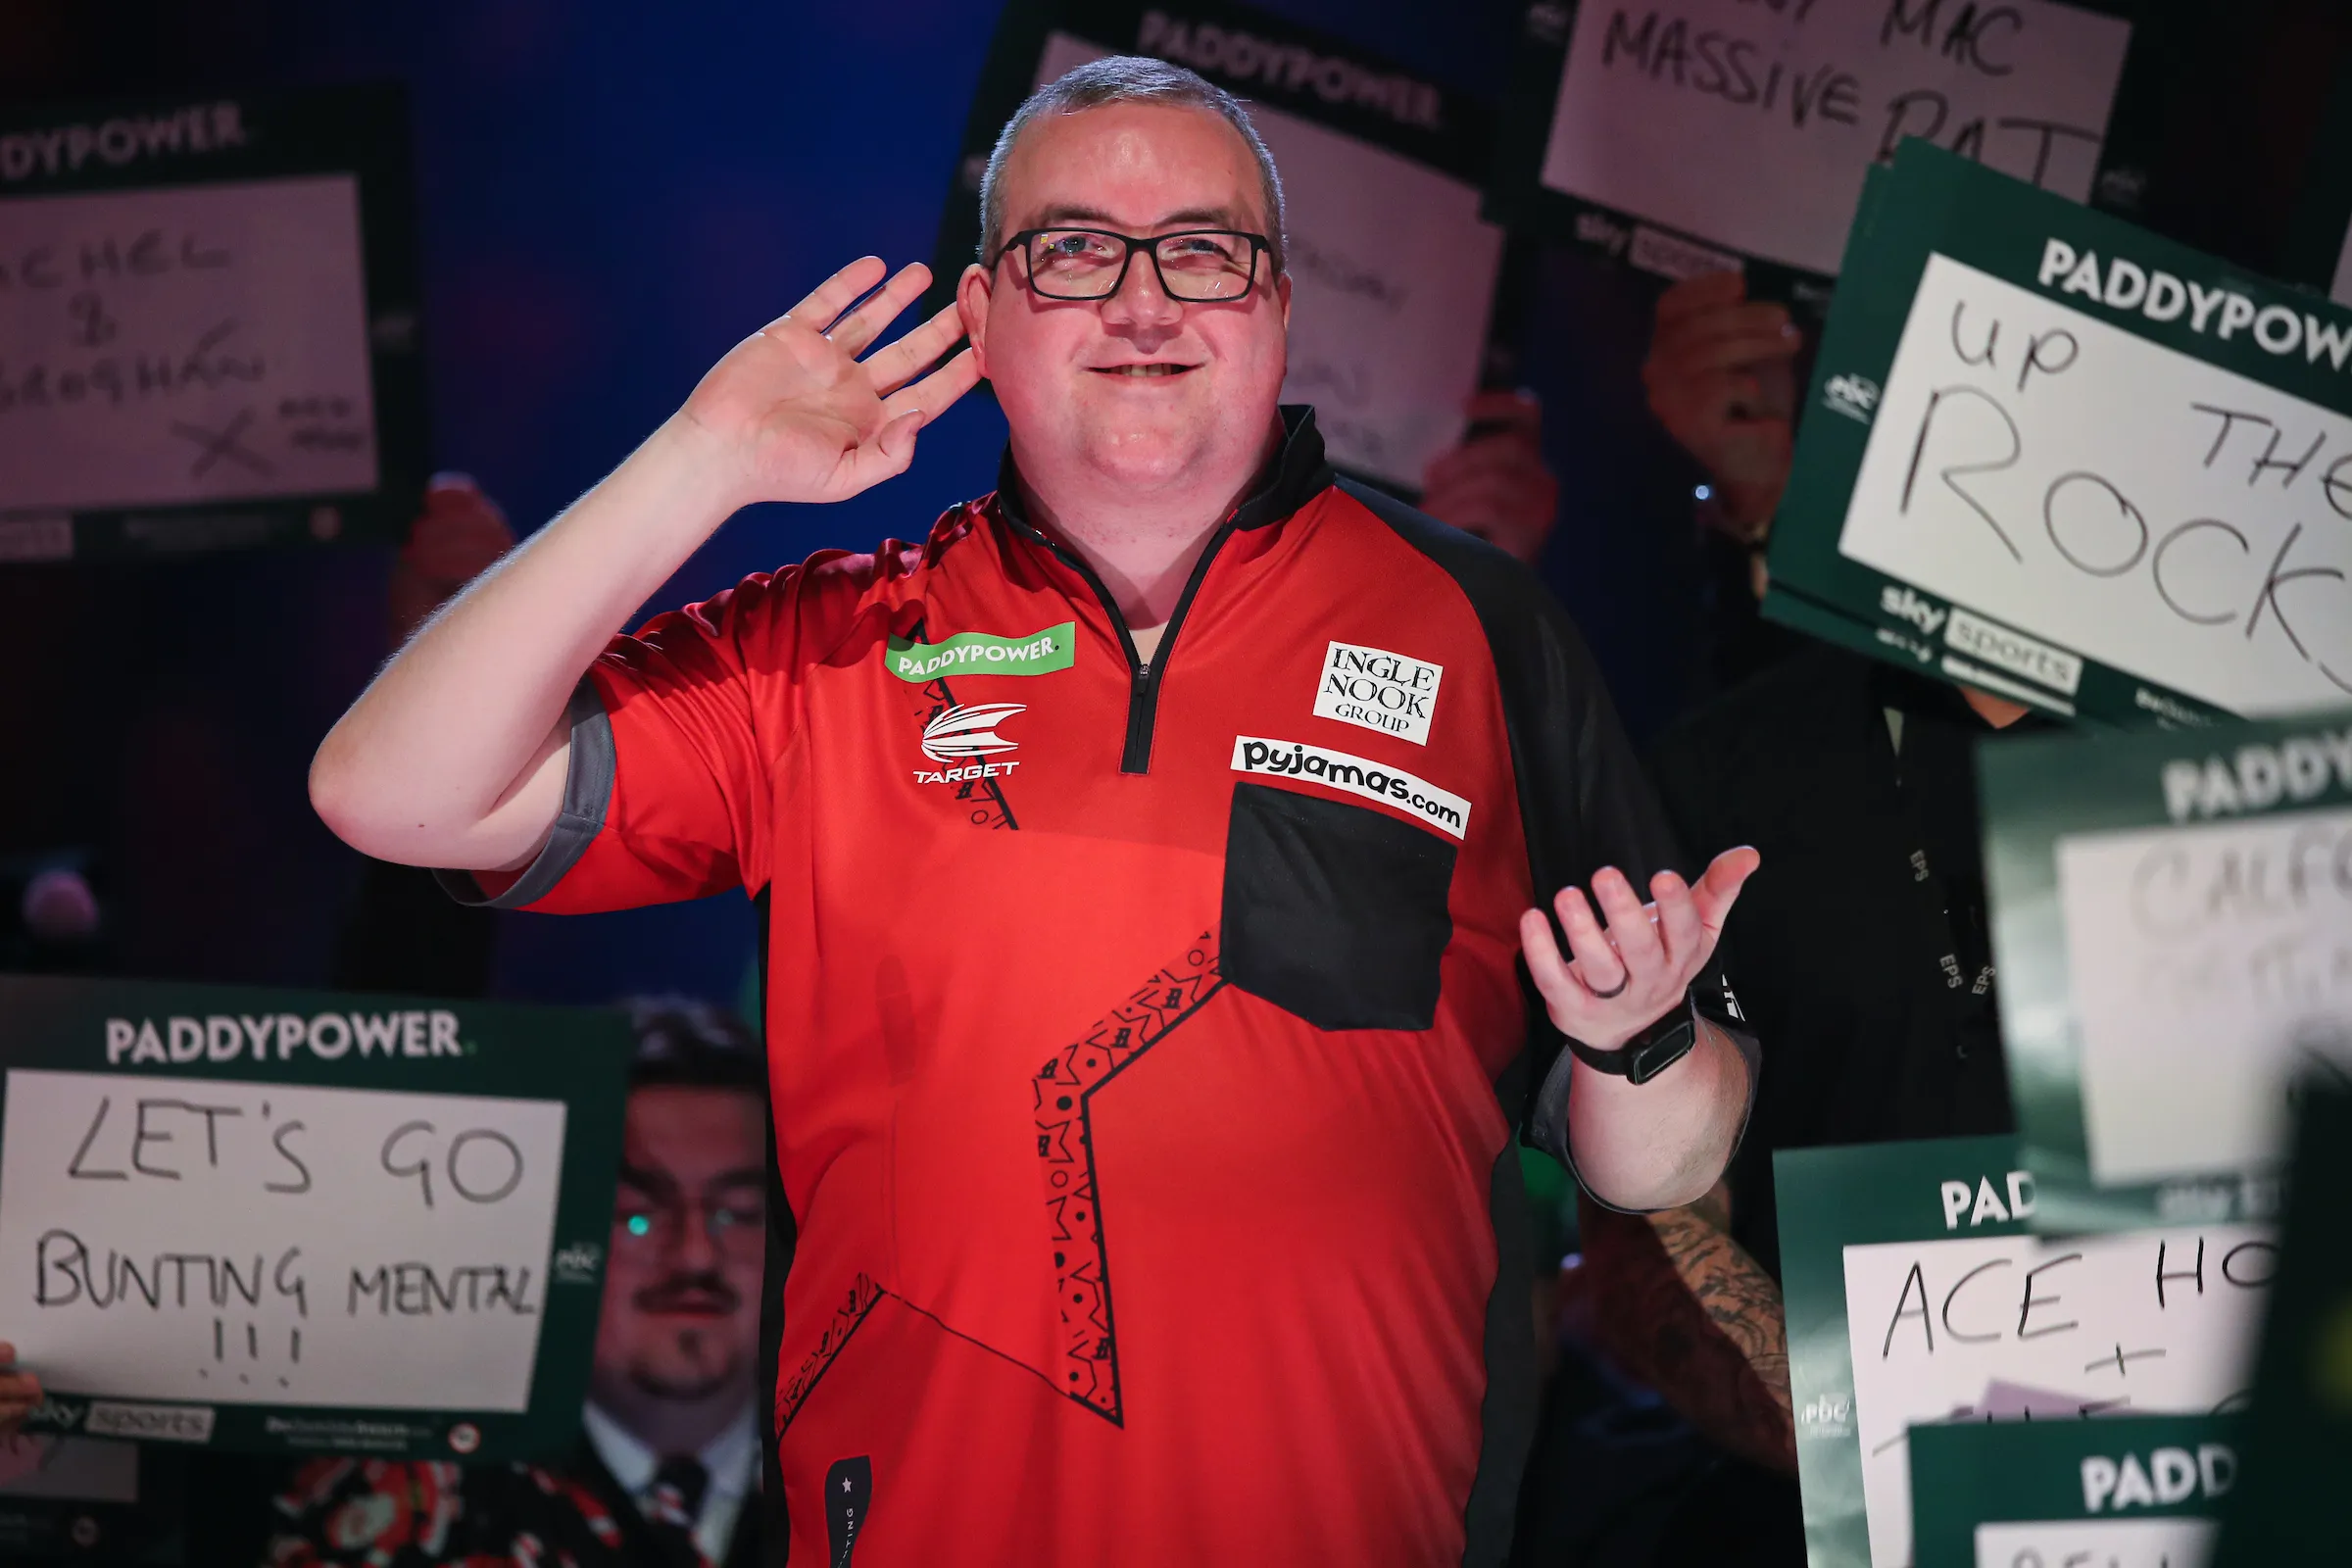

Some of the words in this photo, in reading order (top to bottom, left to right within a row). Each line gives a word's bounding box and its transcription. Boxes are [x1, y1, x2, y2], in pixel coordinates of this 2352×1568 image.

[1331, 648, 1435, 692] INGLE
[1323, 672, 1429, 719] NOOK
[1335, 703, 1409, 732] GROUP
[913, 761, 1020, 784] TARGET
[1243, 741, 1460, 828] pyjamas.com
[1910, 850, 1930, 882] EPS
[1939, 954, 1964, 989] EPS
[1972, 965, 1996, 995] EPS
[69, 1096, 311, 1194] LET'S
[380, 1120, 523, 1208] GO
[33, 1229, 308, 1318] BUNTING
[347, 1261, 536, 1317] MENTAL
[1882, 1253, 2082, 1360] ACE
